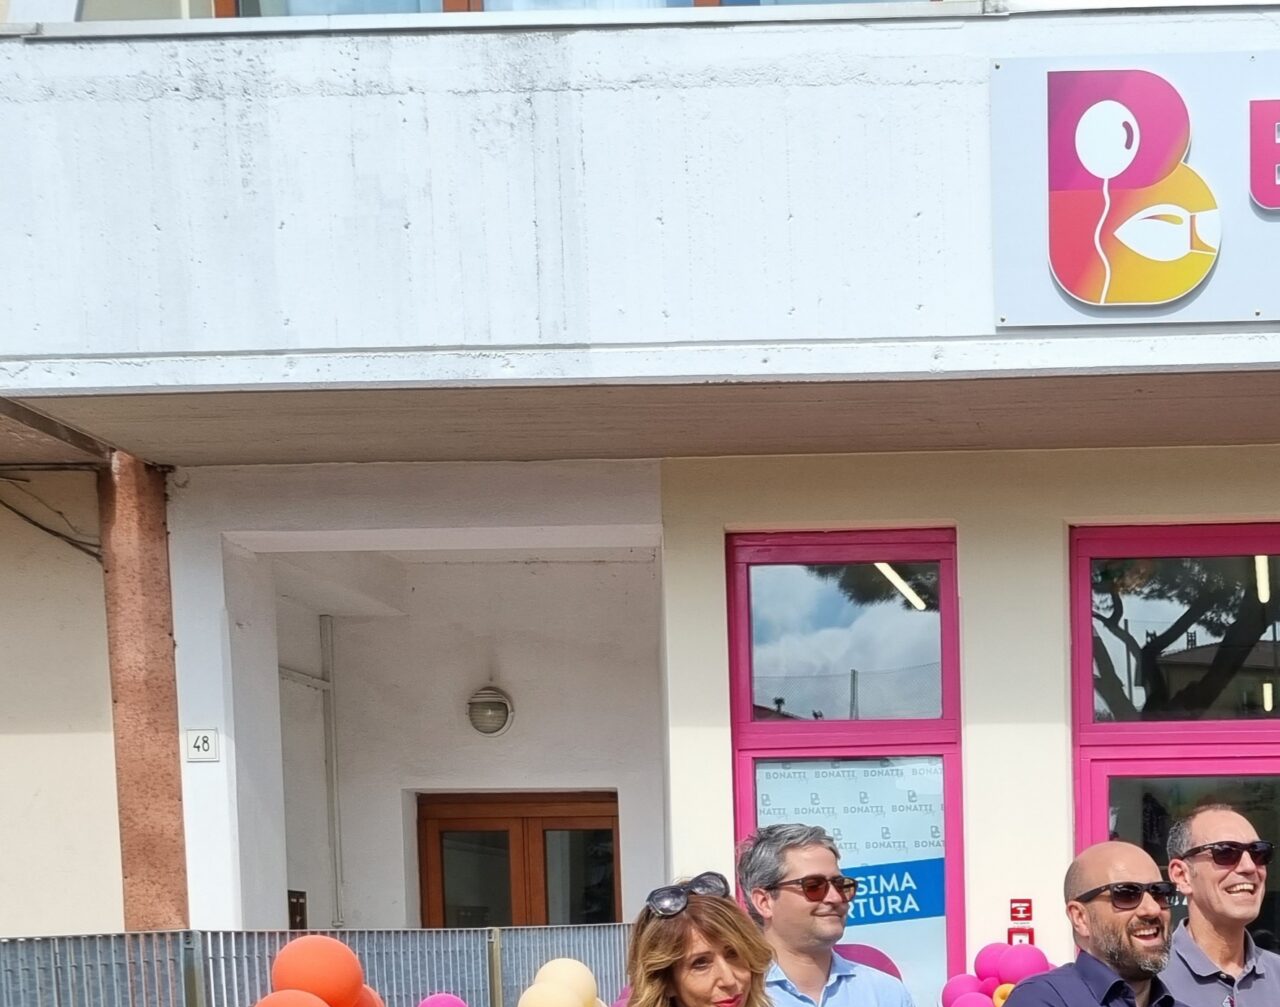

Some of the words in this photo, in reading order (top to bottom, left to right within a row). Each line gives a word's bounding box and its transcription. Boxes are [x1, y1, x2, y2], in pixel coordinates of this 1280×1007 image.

[193, 736, 210, 752] 48
[765, 771, 807, 780] BONATTI
[814, 769, 855, 779] BONATTI
[863, 768, 904, 778] BONATTI
[794, 806, 836, 815] BONATTI
[843, 805, 884, 814] BONATTI
[891, 804, 933, 813] BONATTI
[865, 841, 906, 849] BONATTI
